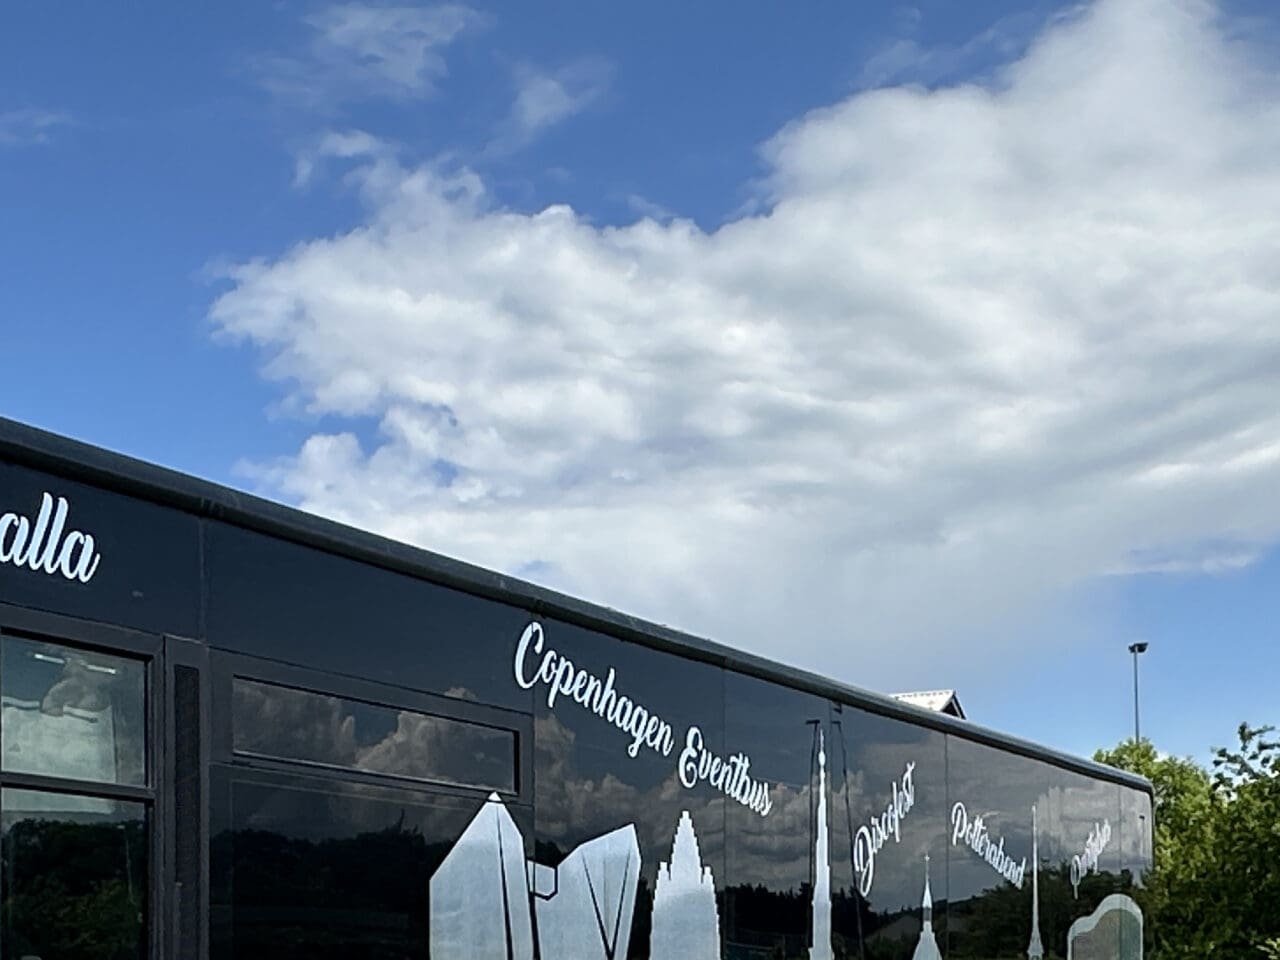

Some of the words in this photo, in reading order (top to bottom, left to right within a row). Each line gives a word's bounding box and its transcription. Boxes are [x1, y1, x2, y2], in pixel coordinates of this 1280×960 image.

[515, 622, 675, 758] Copenhagen
[678, 726, 773, 816] Eventbus
[853, 761, 916, 898] Discofest
[951, 801, 1026, 890] Polterabend
